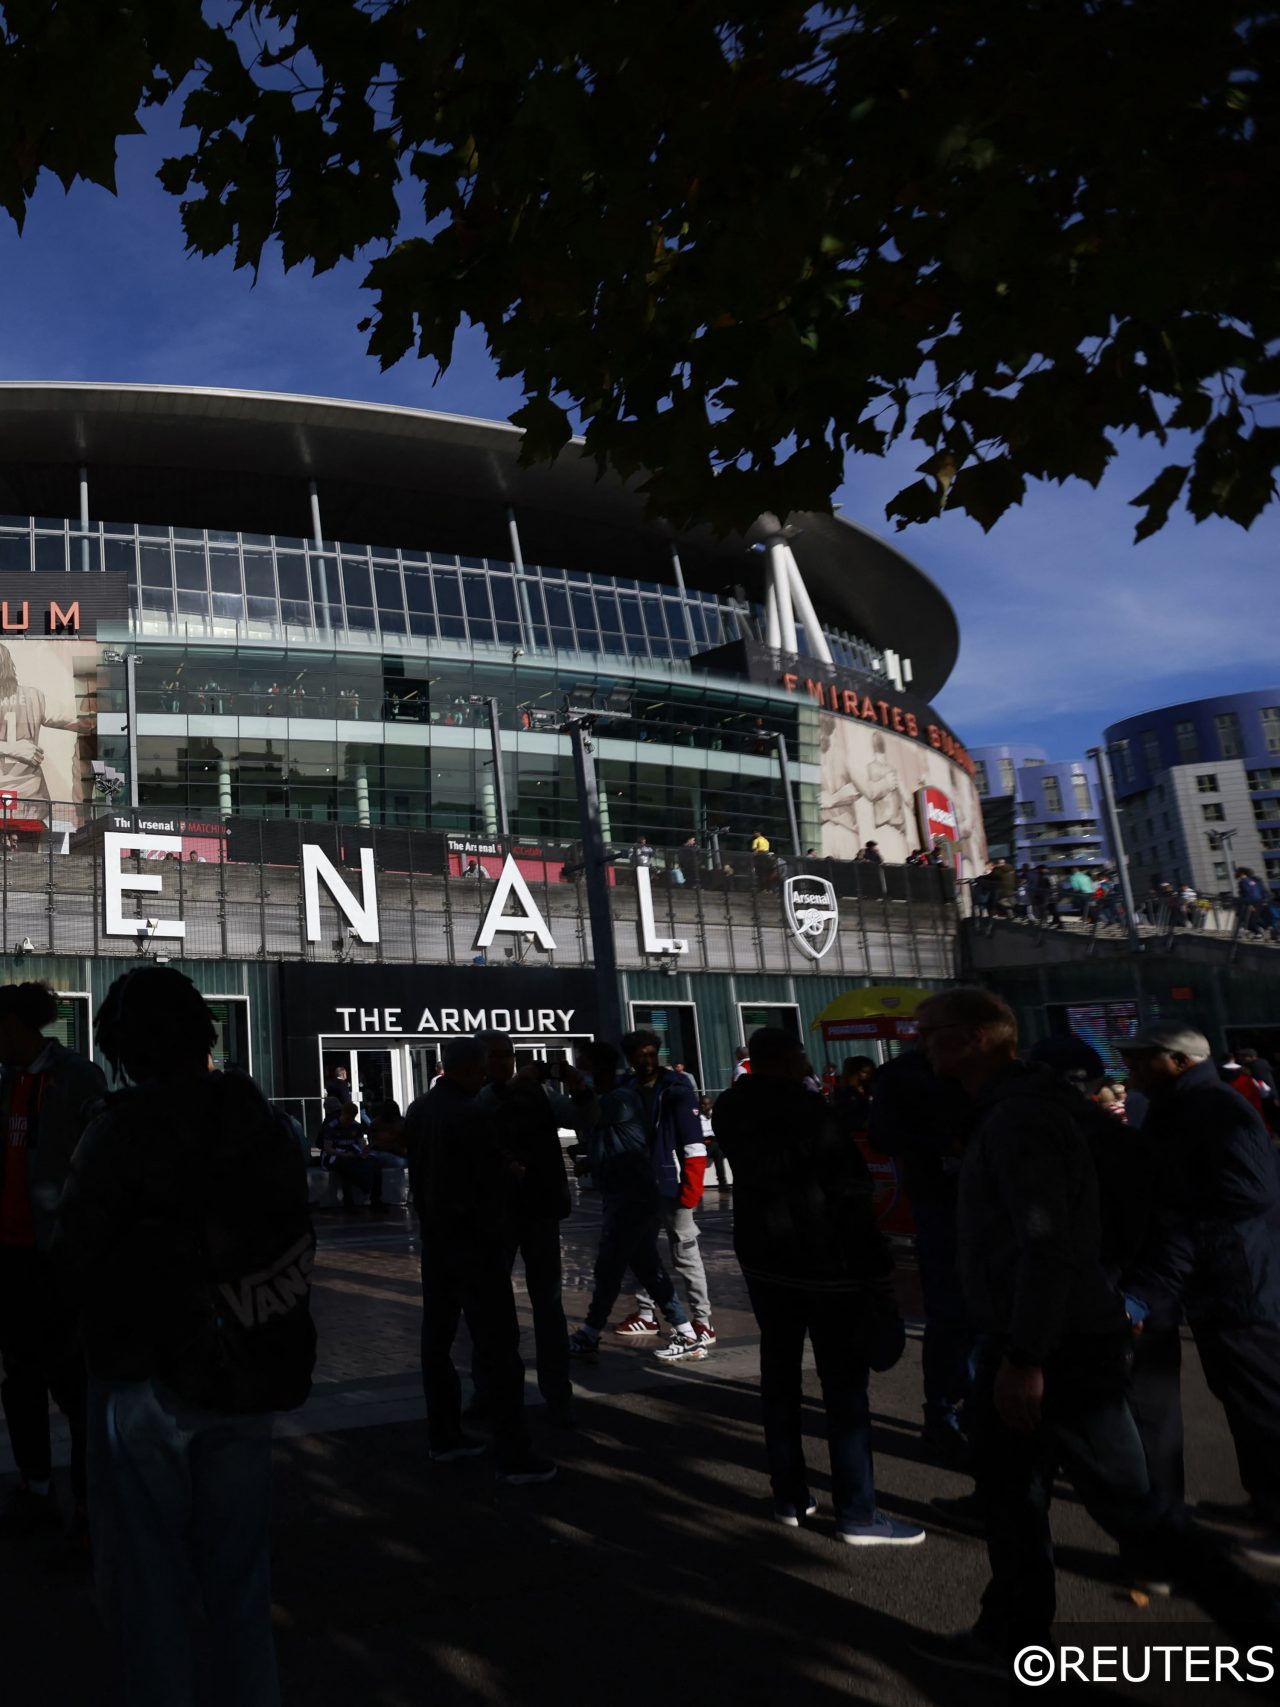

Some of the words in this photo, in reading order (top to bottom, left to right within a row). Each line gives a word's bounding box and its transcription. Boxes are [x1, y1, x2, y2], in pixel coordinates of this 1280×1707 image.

[783, 673, 919, 737] EMIRATES
[448, 840, 464, 851] The
[792, 890, 831, 905] Arsenal
[335, 1007, 403, 1032] THE
[416, 1007, 576, 1032] ARMOURY
